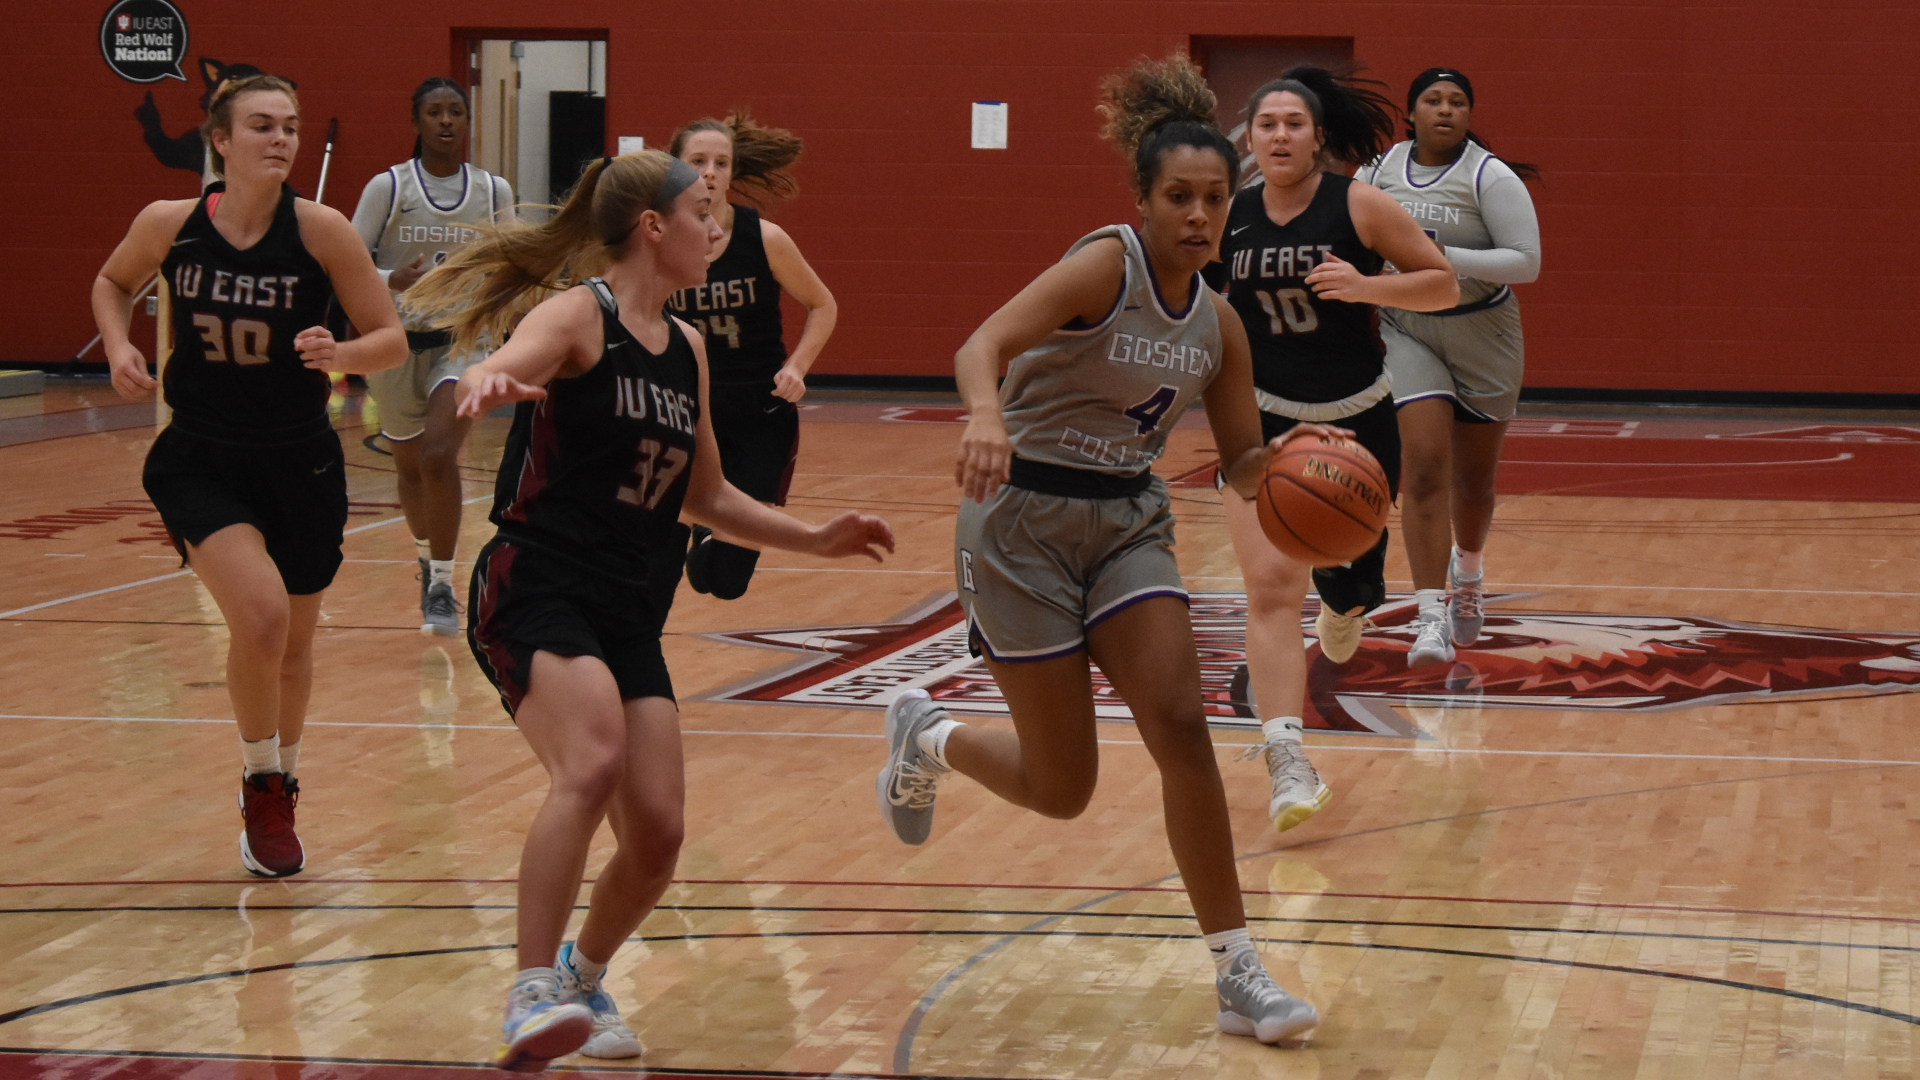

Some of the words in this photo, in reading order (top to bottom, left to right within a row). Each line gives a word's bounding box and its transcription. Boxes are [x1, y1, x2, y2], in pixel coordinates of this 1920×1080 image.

[115, 33, 141, 46] Red
[142, 33, 173, 46] Wolf
[132, 17, 144, 30] IU
[146, 17, 174, 30] EAST
[115, 47, 173, 61] Nation!
[1400, 201, 1460, 225] SHEN
[1231, 249, 1253, 280] IU
[1260, 245, 1332, 278] EAST
[175, 264, 202, 298] IU
[212, 270, 299, 309] EAST
[695, 277, 757, 311] EAST
[1255, 288, 1319, 335] 10
[192, 313, 272, 366] 30
[1107, 332, 1213, 377] GOSHEN
[615, 375, 647, 420] IU
[1122, 384, 1180, 437] 4
[1057, 426, 1165, 467] COLL
[616, 438, 689, 510] 33
[807, 674, 915, 701] EAST
